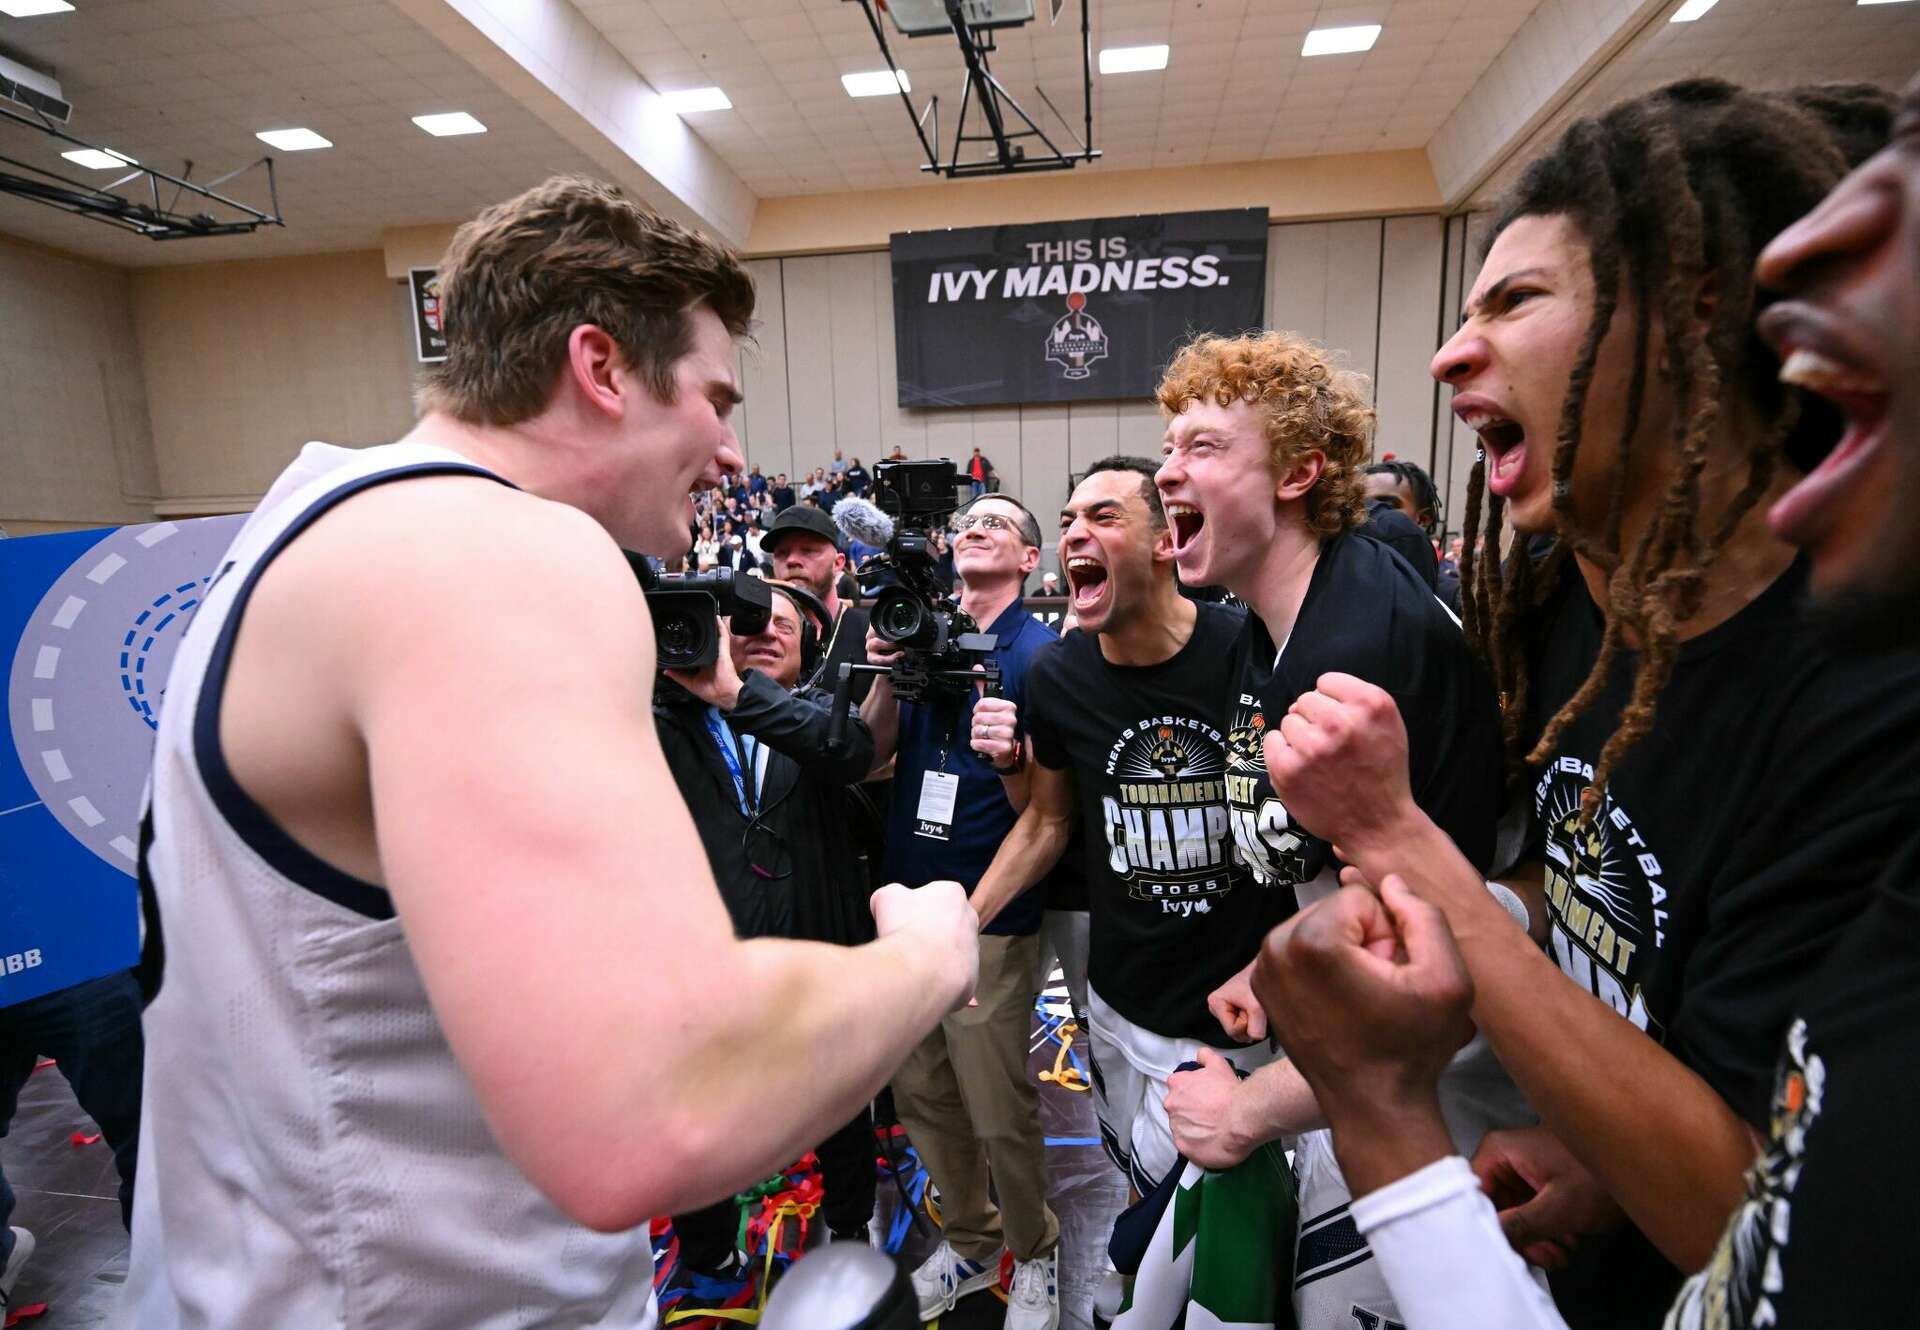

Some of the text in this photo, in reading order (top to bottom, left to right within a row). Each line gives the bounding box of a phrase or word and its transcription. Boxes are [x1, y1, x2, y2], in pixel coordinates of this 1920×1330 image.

[1026, 237, 1128, 264] THIS IS
[927, 254, 1231, 303] IVY MADNESS.
[1105, 716, 1226, 775] MEN'S BASKETBA
[1119, 780, 1225, 805] TOURNAMENT
[921, 821, 936, 834] Ivy
[1102, 796, 1228, 874] CHAMP
[1560, 756, 1669, 949] BAETBALL
[1152, 880, 1218, 895] 2025
[1161, 899, 1197, 917] Ivy
